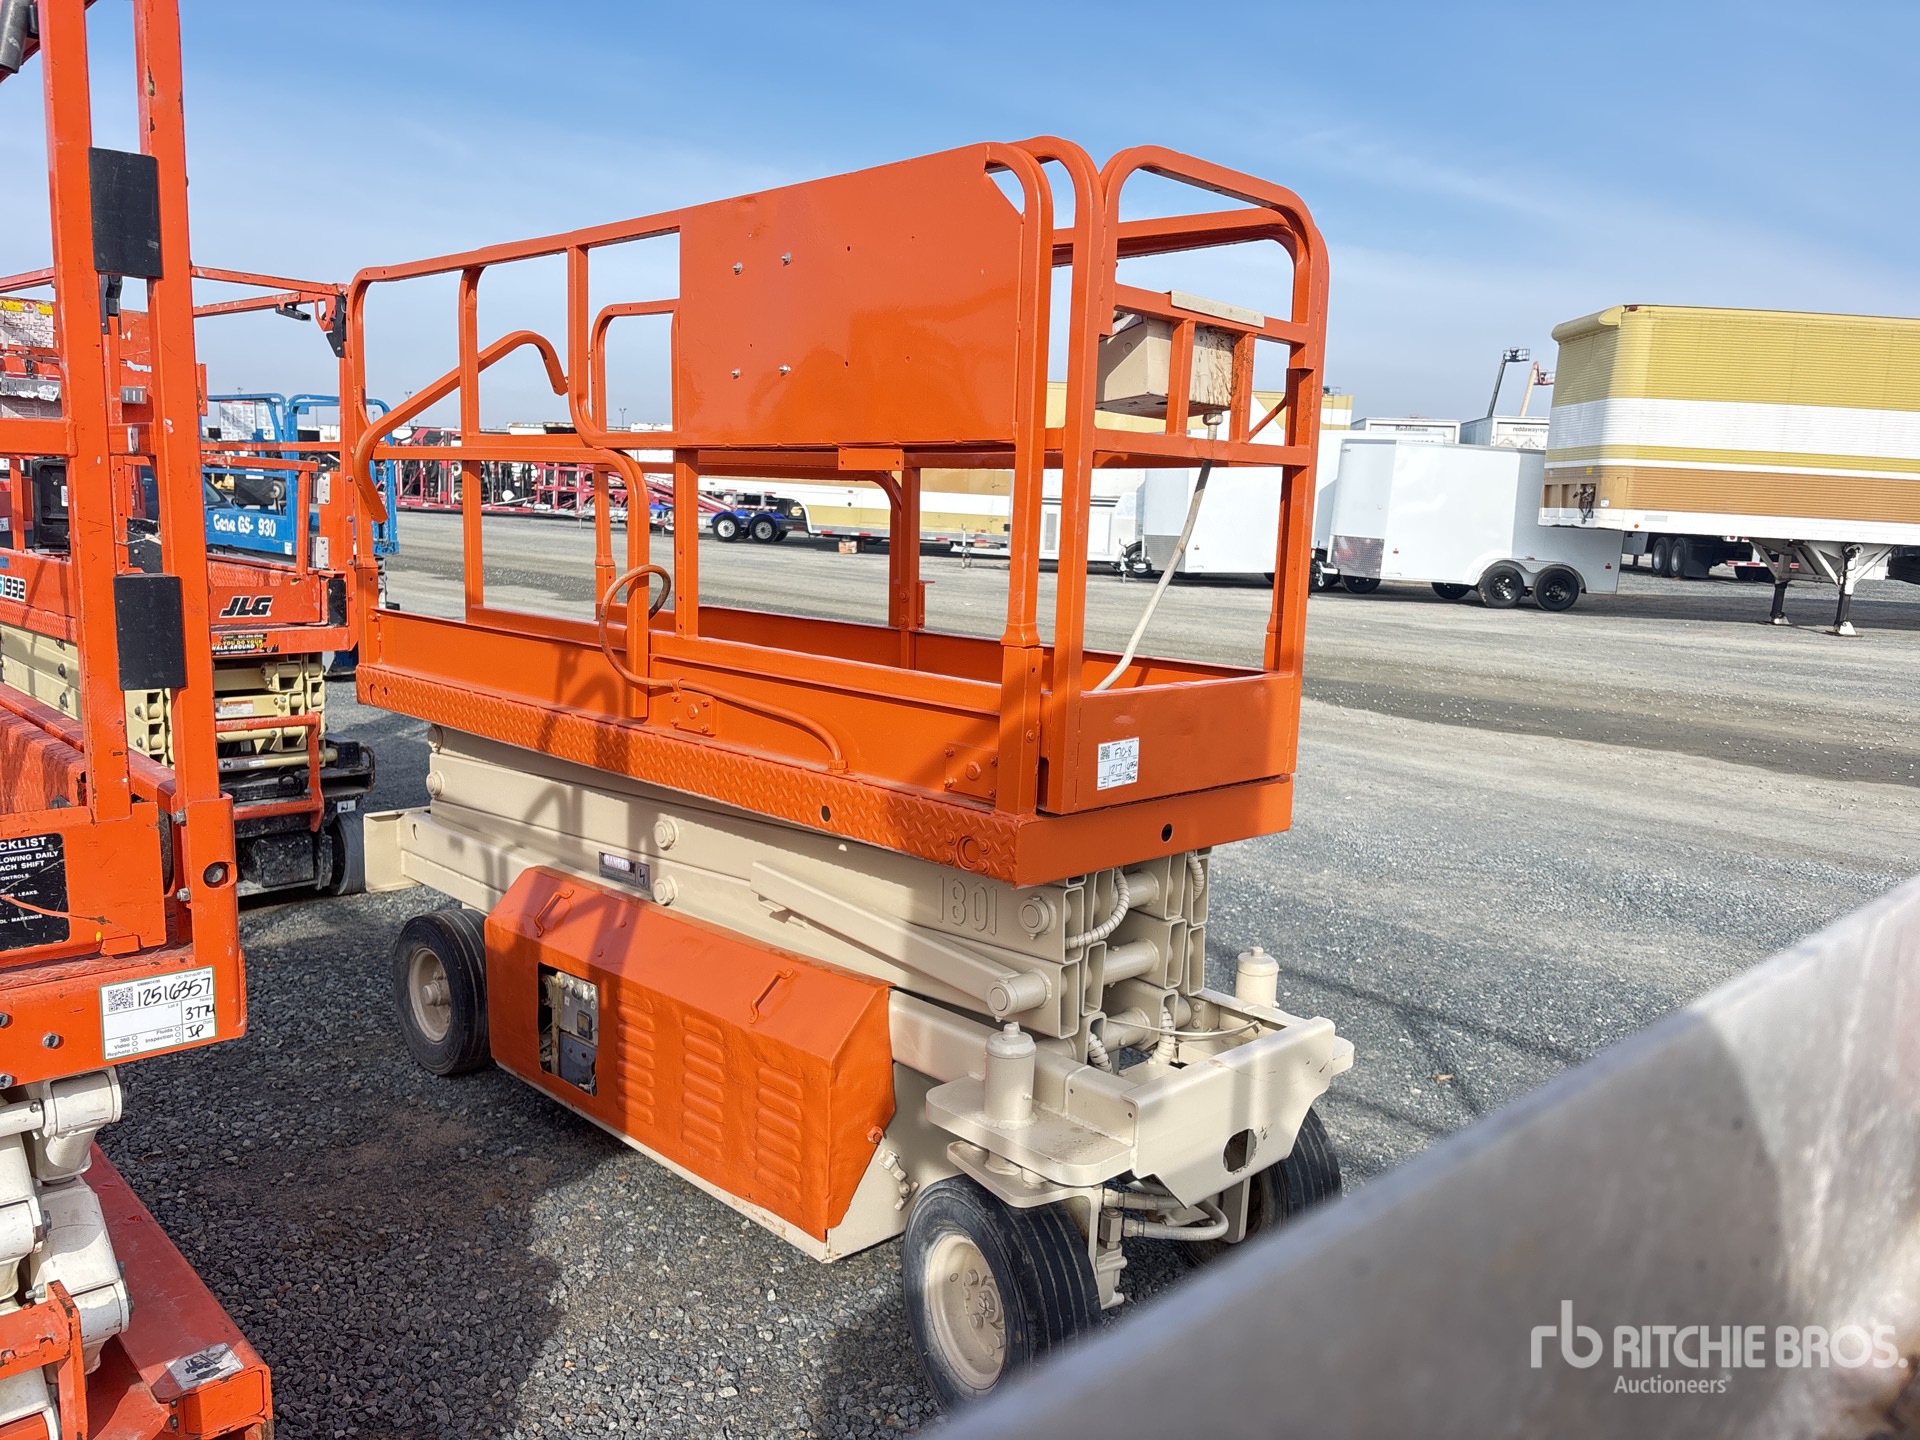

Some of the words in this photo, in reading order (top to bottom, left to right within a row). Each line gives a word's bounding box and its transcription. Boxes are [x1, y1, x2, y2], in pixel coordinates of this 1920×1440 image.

[219, 596, 273, 618] JLG
[36, 850, 59, 859] DAILY
[21, 860, 45, 869] SHIFT
[138, 977, 211, 1007] 12516357
[145, 1034, 174, 1043] Inspection
[107, 1049, 130, 1057] Rephoto
